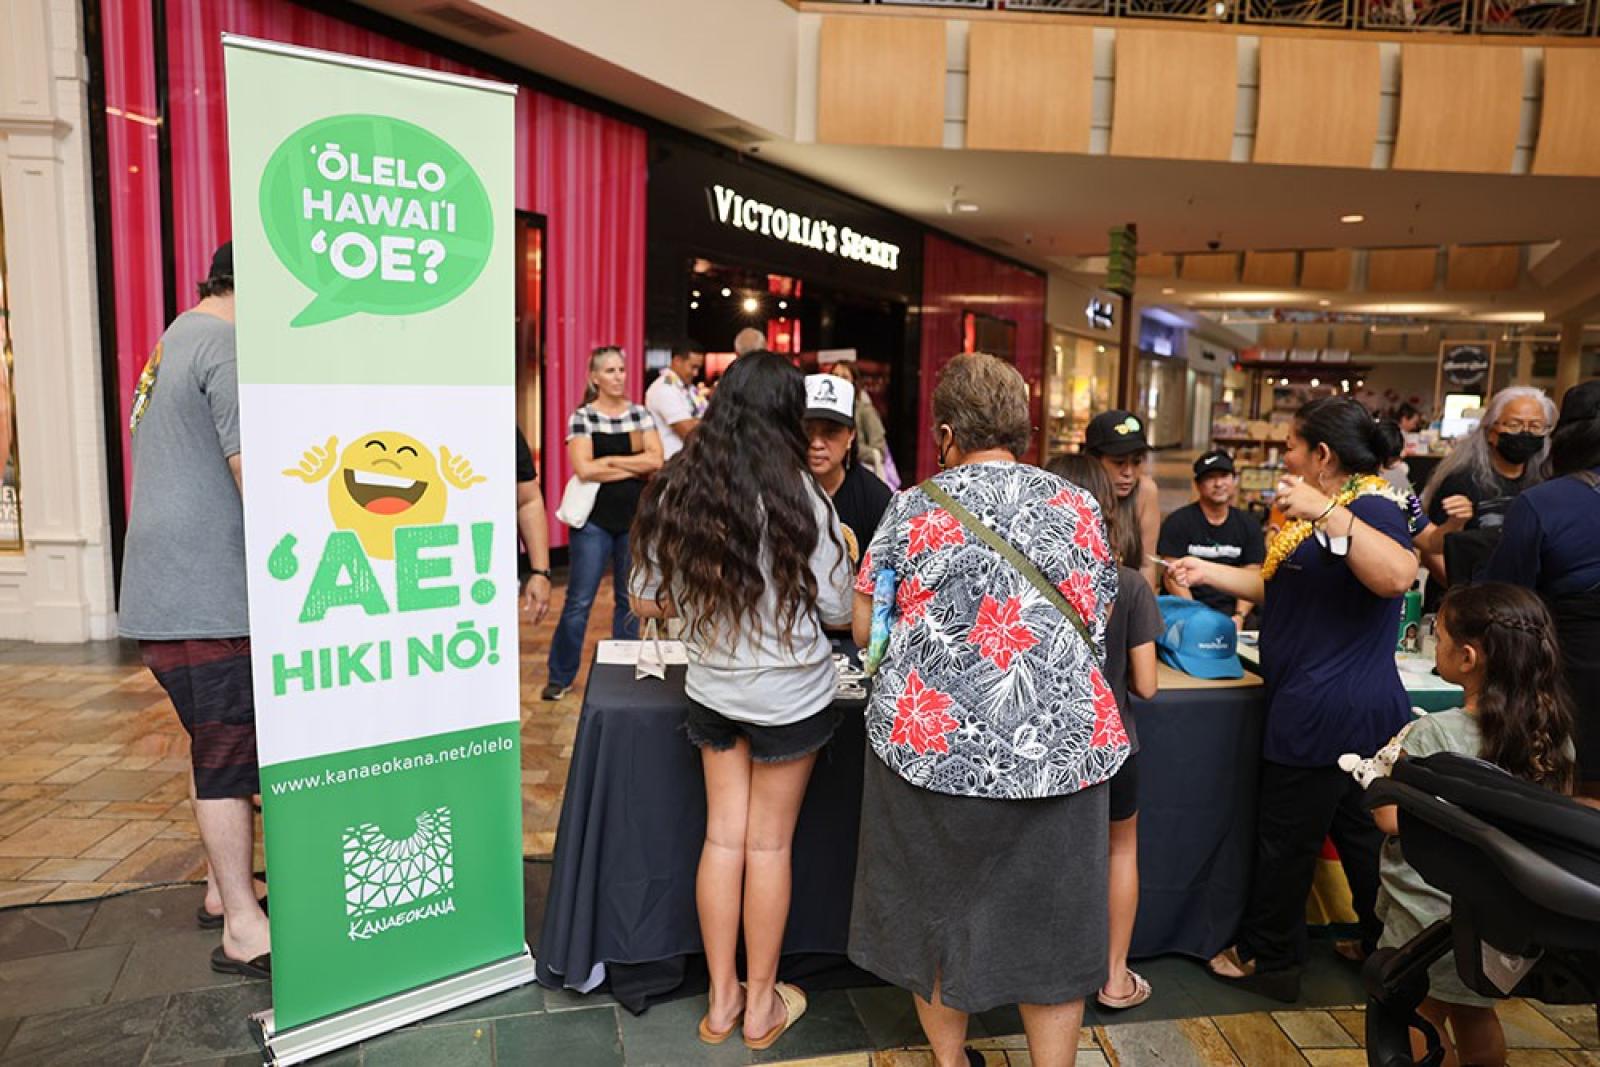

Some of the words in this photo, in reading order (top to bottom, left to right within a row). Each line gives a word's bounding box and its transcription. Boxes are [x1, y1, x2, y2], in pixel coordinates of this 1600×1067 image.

[713, 185, 837, 254] VICTORIA'S
[839, 227, 900, 271] SECRET
[272, 640, 392, 696] HIKI
[407, 620, 500, 677] NŌ!
[271, 736, 513, 796] www.kanaeokana.net/olelo
[348, 897, 456, 941] KANAEOKANA
